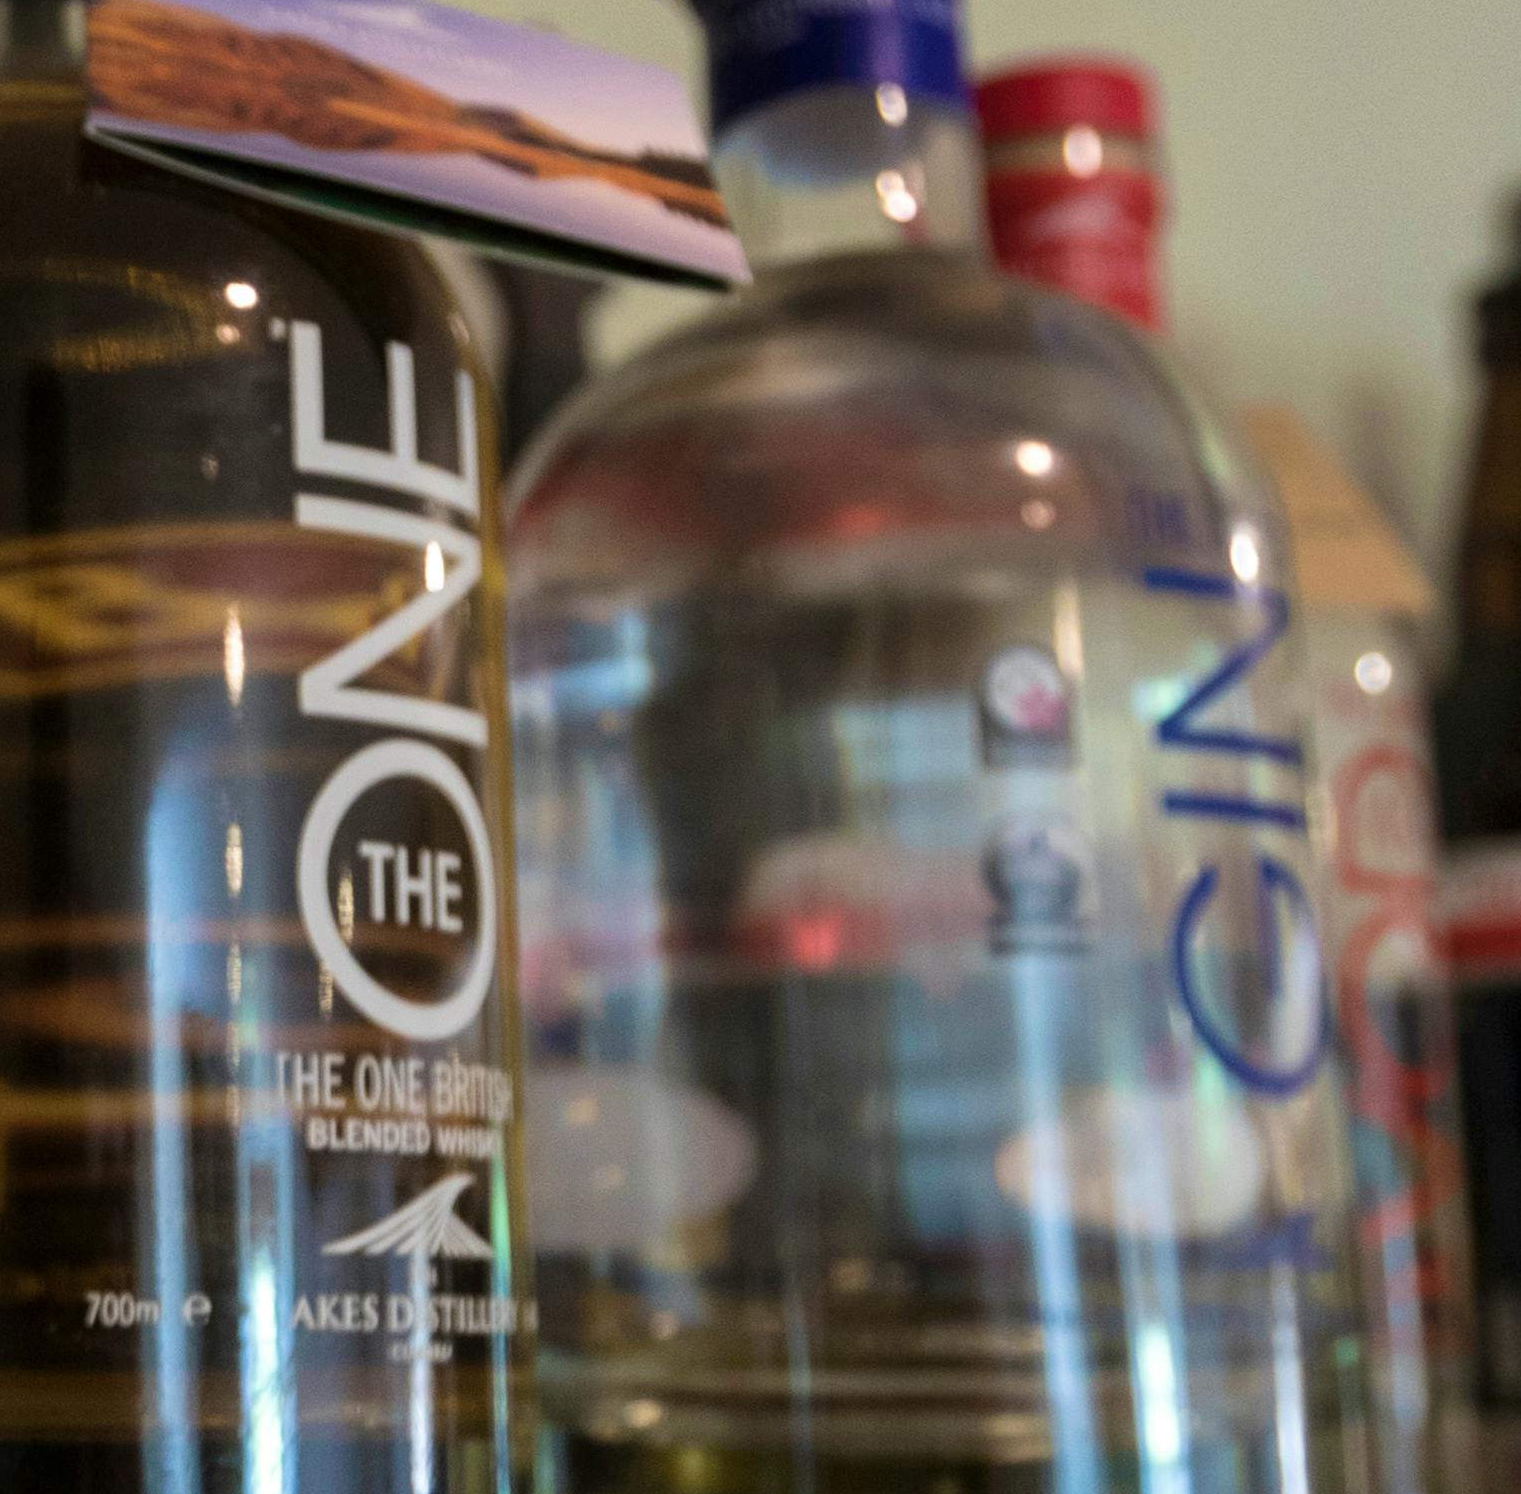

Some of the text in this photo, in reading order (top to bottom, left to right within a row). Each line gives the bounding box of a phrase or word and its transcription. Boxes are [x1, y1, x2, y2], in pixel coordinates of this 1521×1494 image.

[289, 320, 496, 1041] ONE
[358, 839, 465, 935] THE
[275, 1050, 348, 1110] THE
[354, 1053, 426, 1117] ONE
[306, 1115, 433, 1156] BLENDED
[83, 1290, 160, 1328] 700m
[288, 1291, 380, 1334] AKES
